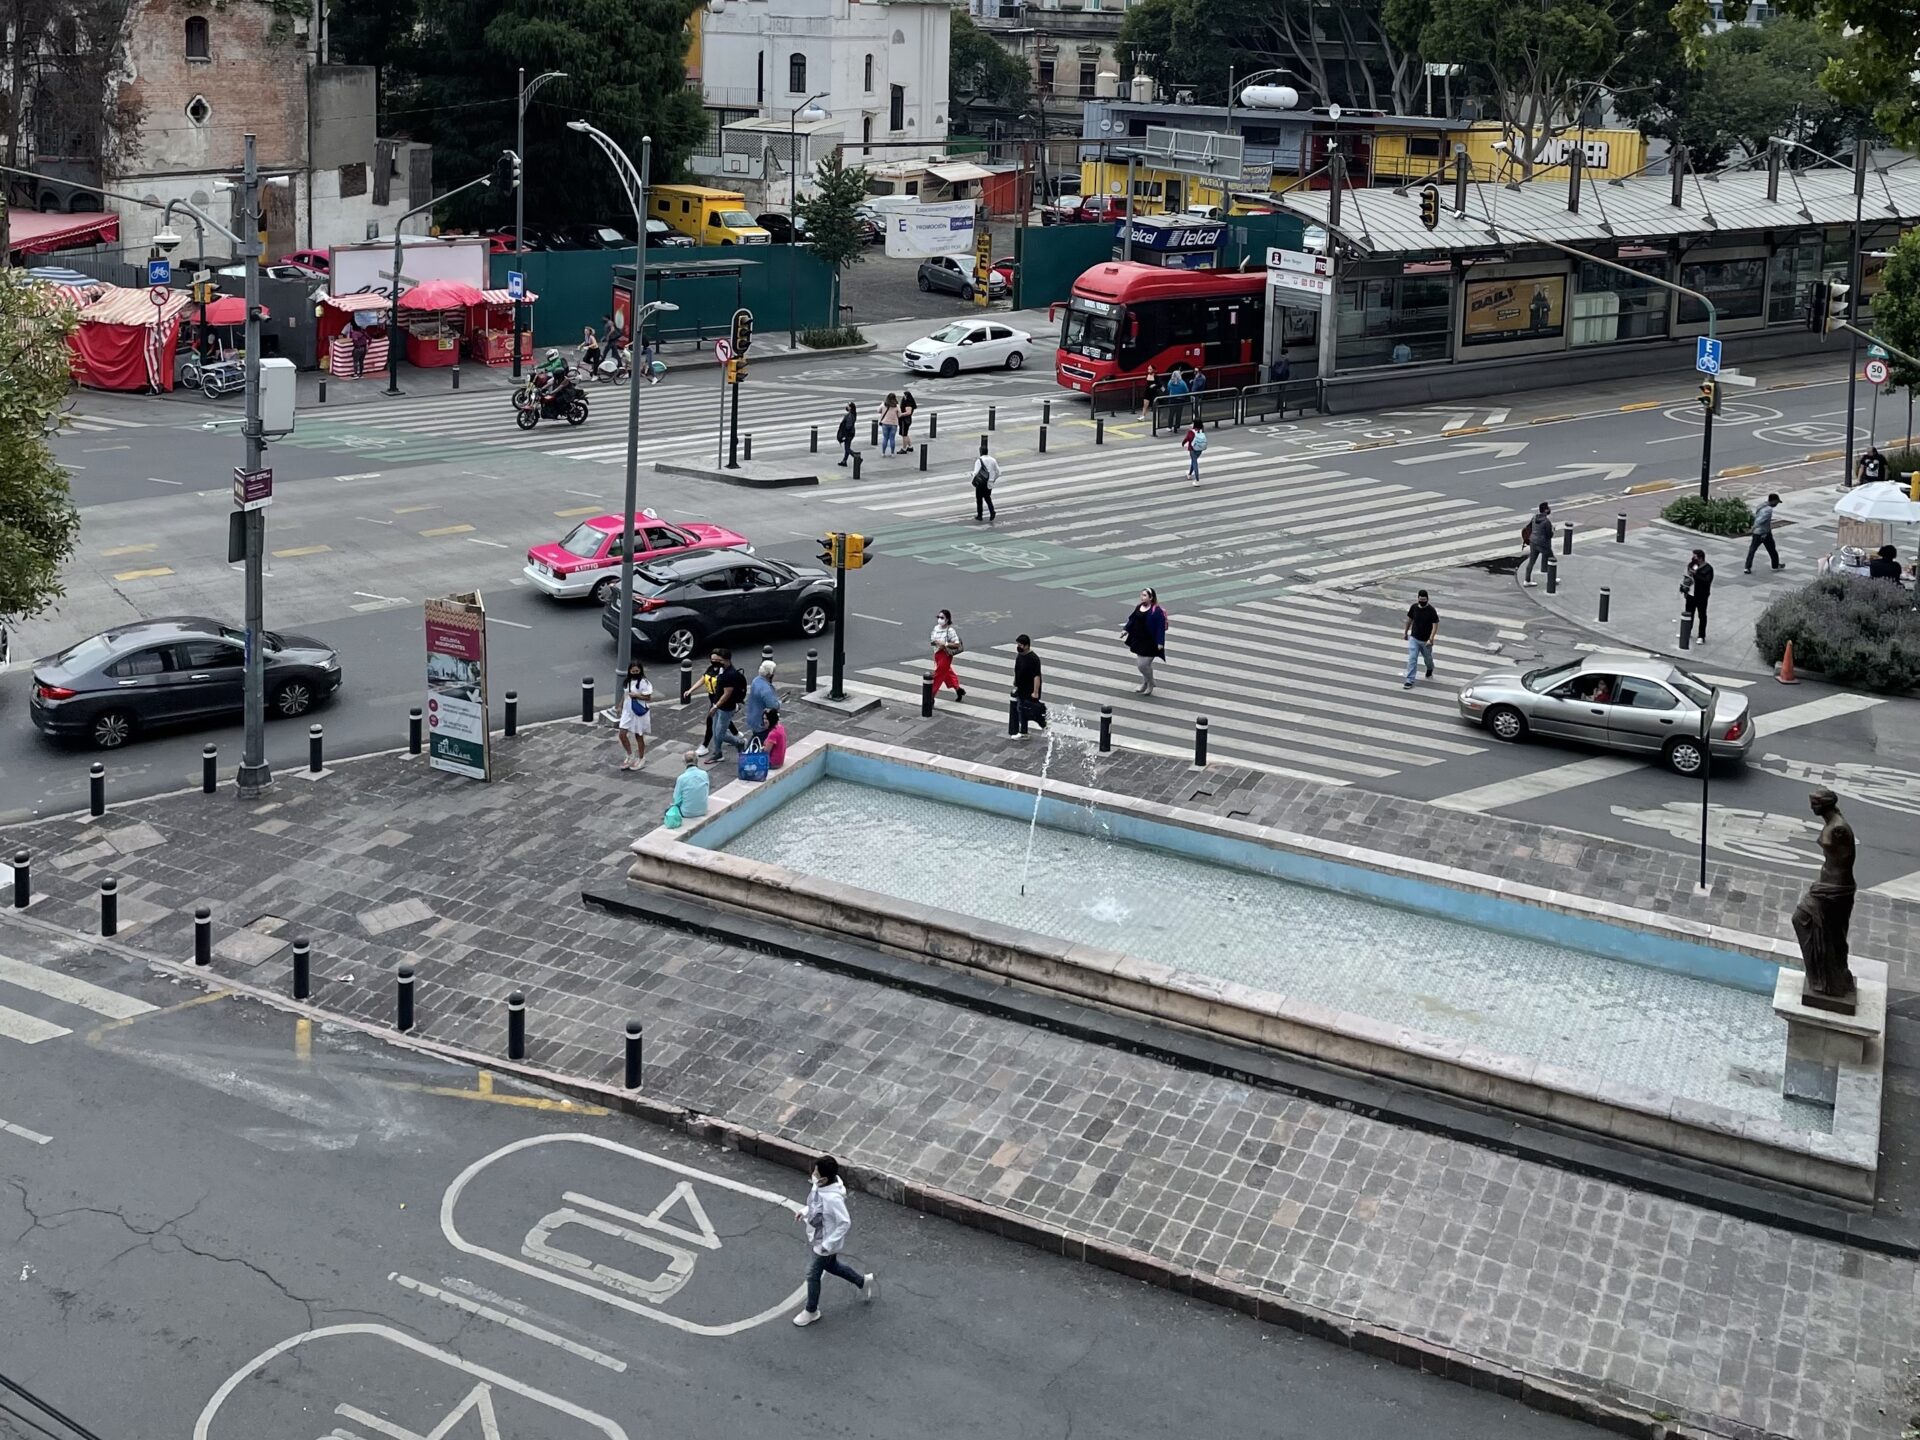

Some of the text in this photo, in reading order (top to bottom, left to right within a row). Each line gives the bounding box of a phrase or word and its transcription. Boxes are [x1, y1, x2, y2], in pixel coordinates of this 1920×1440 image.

[899, 218, 907, 232] E
[1180, 229, 1221, 246] telcel
[979, 254, 988, 270] E
[1706, 340, 1713, 353] E
[1871, 365, 1883, 374] 50
[1321, 418, 1412, 438] BUS
[1775, 424, 1848, 442] 50
[1248, 424, 1357, 450] SOLO
